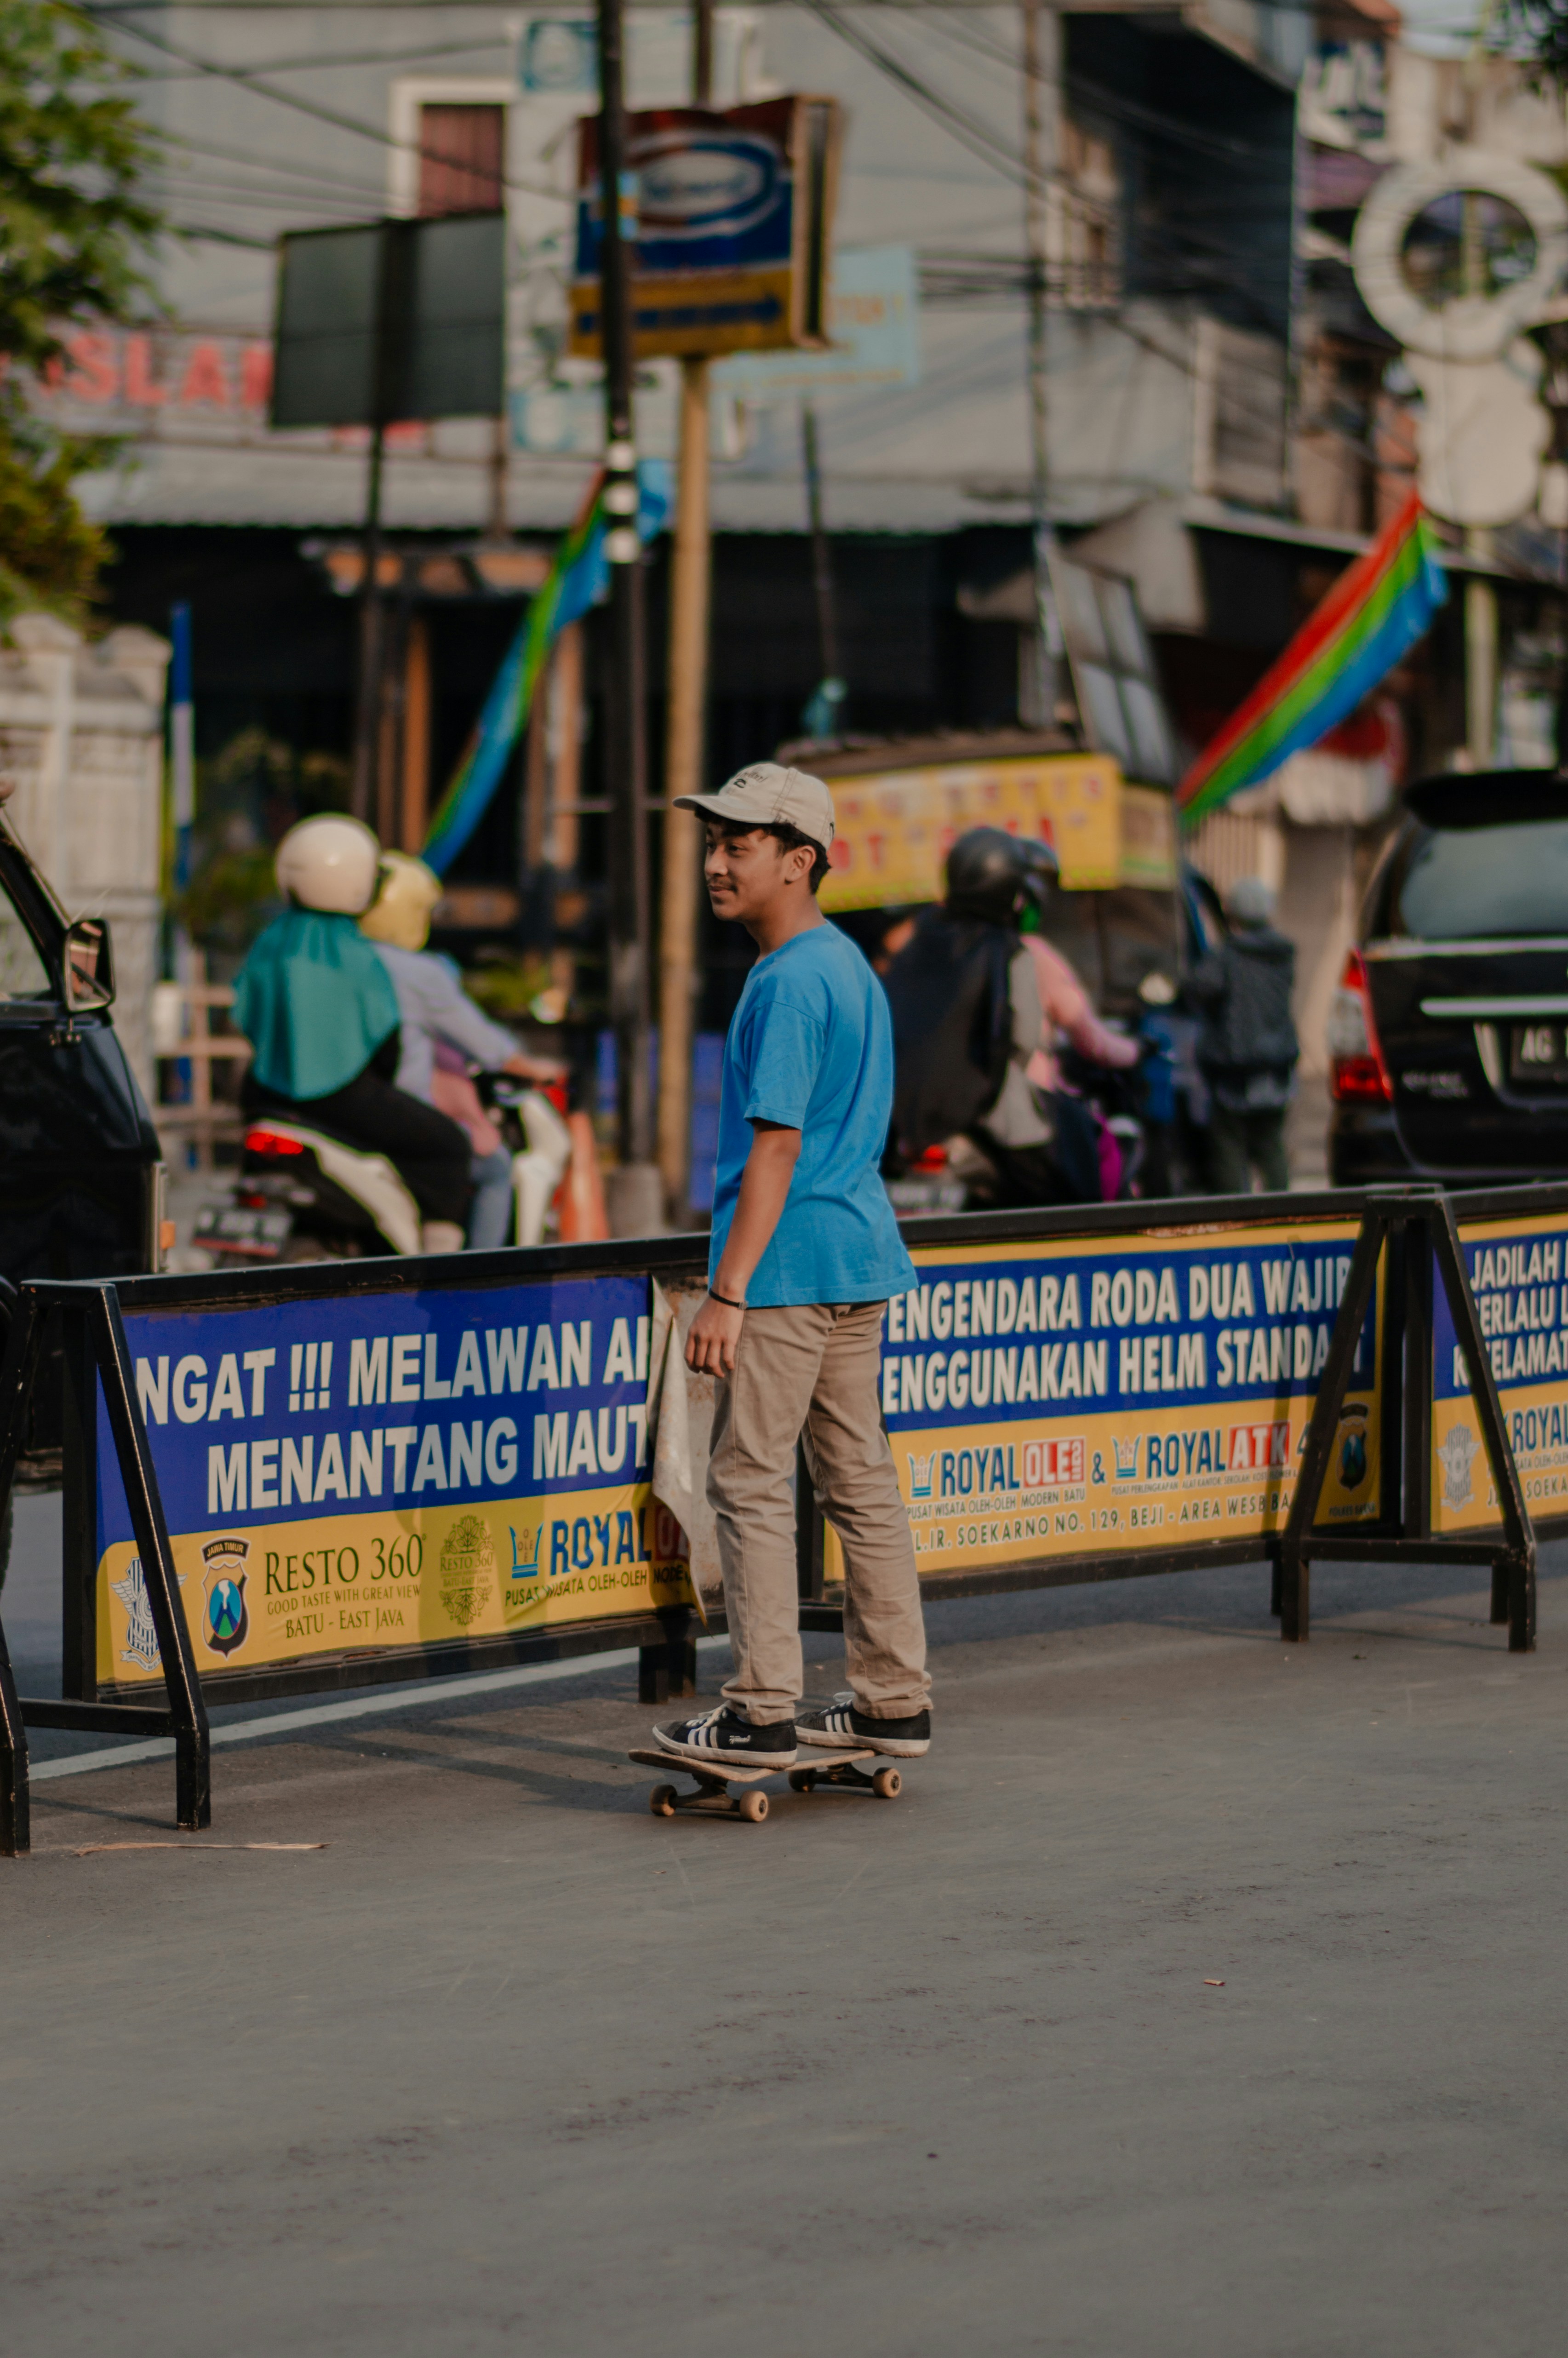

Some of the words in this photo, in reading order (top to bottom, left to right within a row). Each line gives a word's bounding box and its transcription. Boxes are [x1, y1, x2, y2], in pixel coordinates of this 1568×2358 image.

[1470, 1240, 1559, 1291] JADILAH
[881, 1273, 1081, 1343] ENGENDARA
[1091, 1268, 1179, 1328] RODA
[1189, 1262, 1253, 1321] DUA
[1475, 1286, 1556, 1335] ERLALU
[288, 1341, 333, 1412] !!!
[348, 1320, 592, 1406] MELAWAN
[1119, 1333, 1206, 1394] HELM
[1216, 1323, 1365, 1388] STANDA
[208, 1417, 517, 1514] MENANTANG
[533, 1404, 648, 1480] MAUT
[941, 1445, 1020, 1497] ROYAL
[1092, 1452, 1105, 1484] &
[1146, 1429, 1226, 1479] ROYAL
[1231, 1425, 1288, 1468] ATK
[907, 1504, 933, 1520] PUSAT
[934, 1501, 966, 1517] WISATA
[968, 1495, 1016, 1513] OLEH-OLEH
[1021, 1490, 1059, 1508] MODERN
[1064, 1488, 1086, 1502] BATU
[958, 1517, 1048, 1546] SOEKARNO
[1055, 1513, 1085, 1533] NO.
[1131, 1507, 1163, 1527] BEJI
[1180, 1504, 1220, 1522] AREA
[207, 1543, 223, 1557] JAWA
[224, 1542, 243, 1553] TIMUR
[440, 1556, 472, 1572] RESTO
[550, 1508, 652, 1576] ROYAL
[264, 1546, 359, 1596] RESTO
[506, 1586, 540, 1607] PUSAT
[588, 1569, 647, 1591] OLEH-OLEH
[267, 1597, 298, 1615] GOOD
[302, 1591, 331, 1608] TASTE
[334, 1588, 359, 1603] WITH
[363, 1586, 394, 1601] GREAT
[397, 1584, 422, 1599] VIEW
[286, 1612, 324, 1638] BATU
[339, 1609, 371, 1630] EAST
[375, 1607, 405, 1633] JAVA
